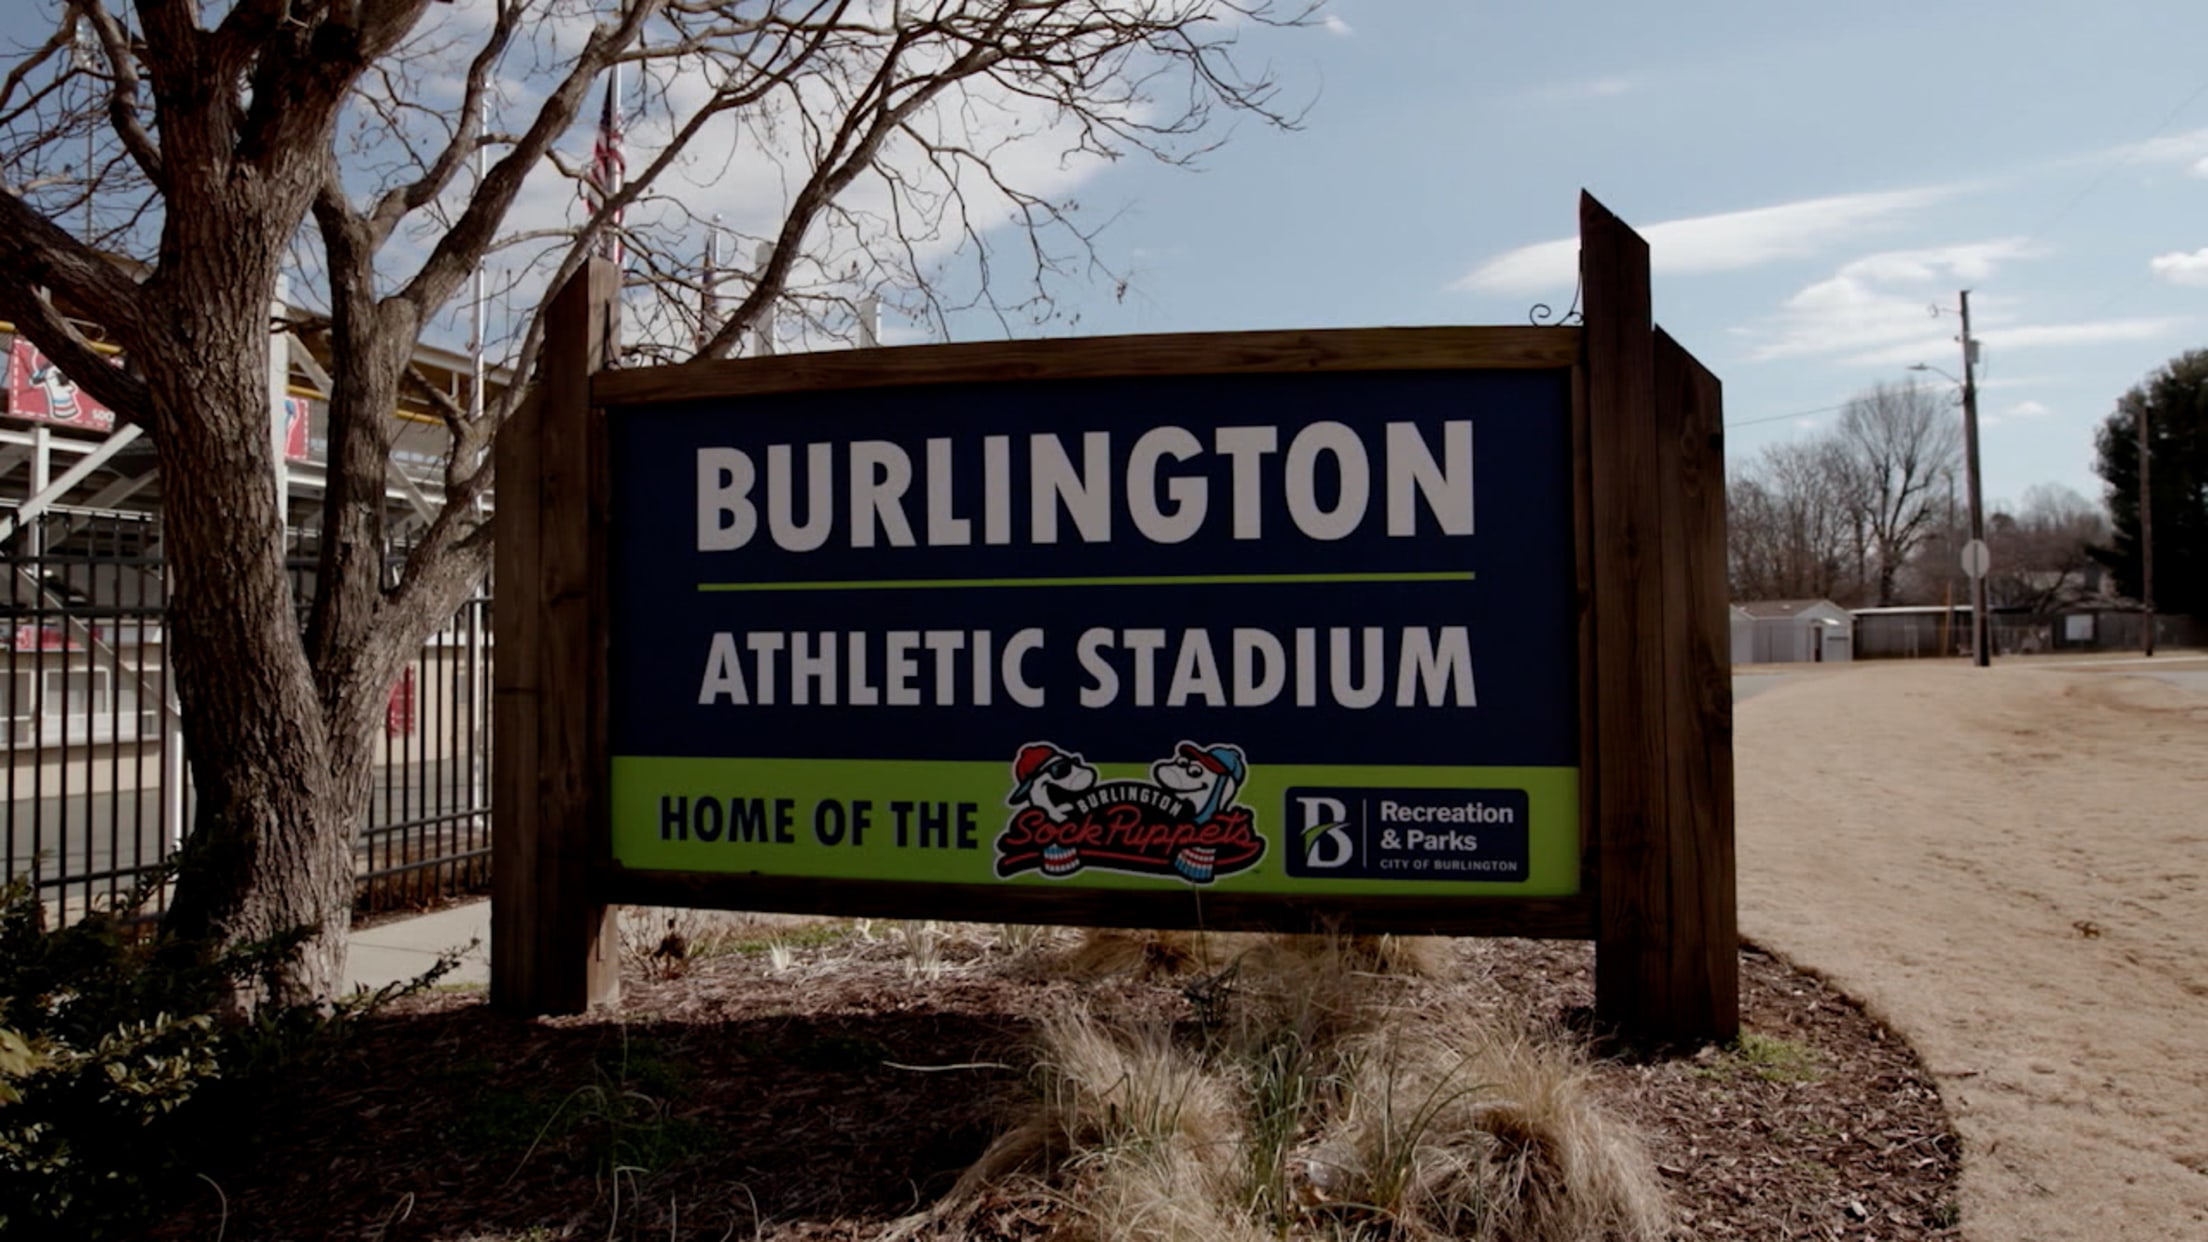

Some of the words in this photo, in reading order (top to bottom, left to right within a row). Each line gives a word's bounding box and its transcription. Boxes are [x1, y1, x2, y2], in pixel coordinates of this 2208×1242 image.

[697, 420, 1475, 552] BURLINGTON
[698, 628, 1045, 708] ATHLETIC
[1076, 626, 1477, 709] STADIUM
[1076, 785, 1184, 817] BURLINGTON
[1380, 800, 1514, 824] Recreation
[661, 796, 795, 842] HOME
[815, 799, 872, 846] OF
[891, 802, 977, 849] THE
[1006, 808, 1102, 846] Sock
[1102, 804, 1260, 855] Puppets
[1380, 828, 1402, 850] &
[1407, 829, 1477, 852] Parks
[1380, 858, 1410, 870] CITY
[1412, 859, 1430, 871] OF
[1433, 859, 1518, 872] BURLINGTON
